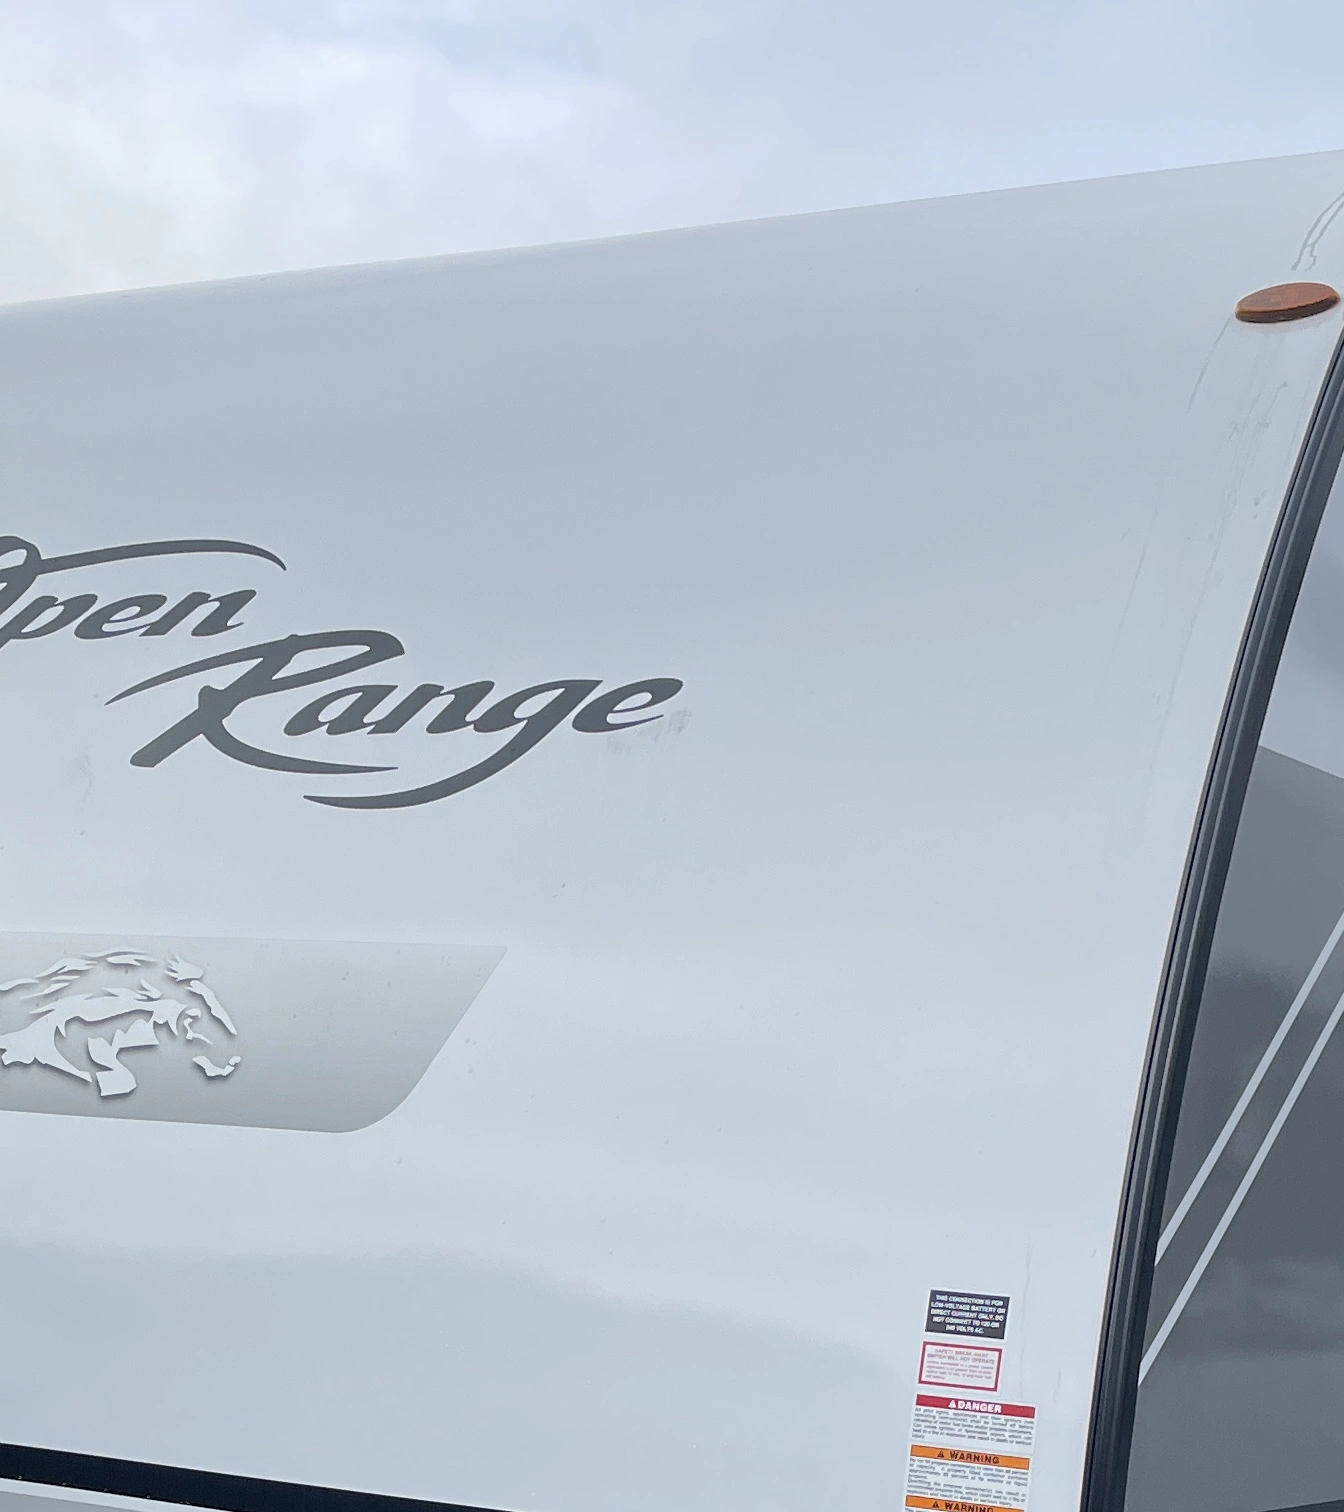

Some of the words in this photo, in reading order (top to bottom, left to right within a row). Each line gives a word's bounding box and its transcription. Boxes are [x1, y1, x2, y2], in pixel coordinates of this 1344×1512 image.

[104, 629, 684, 811] Range
[957, 1400, 1002, 1414] DANGER
[949, 1450, 1000, 1464] WARNING
